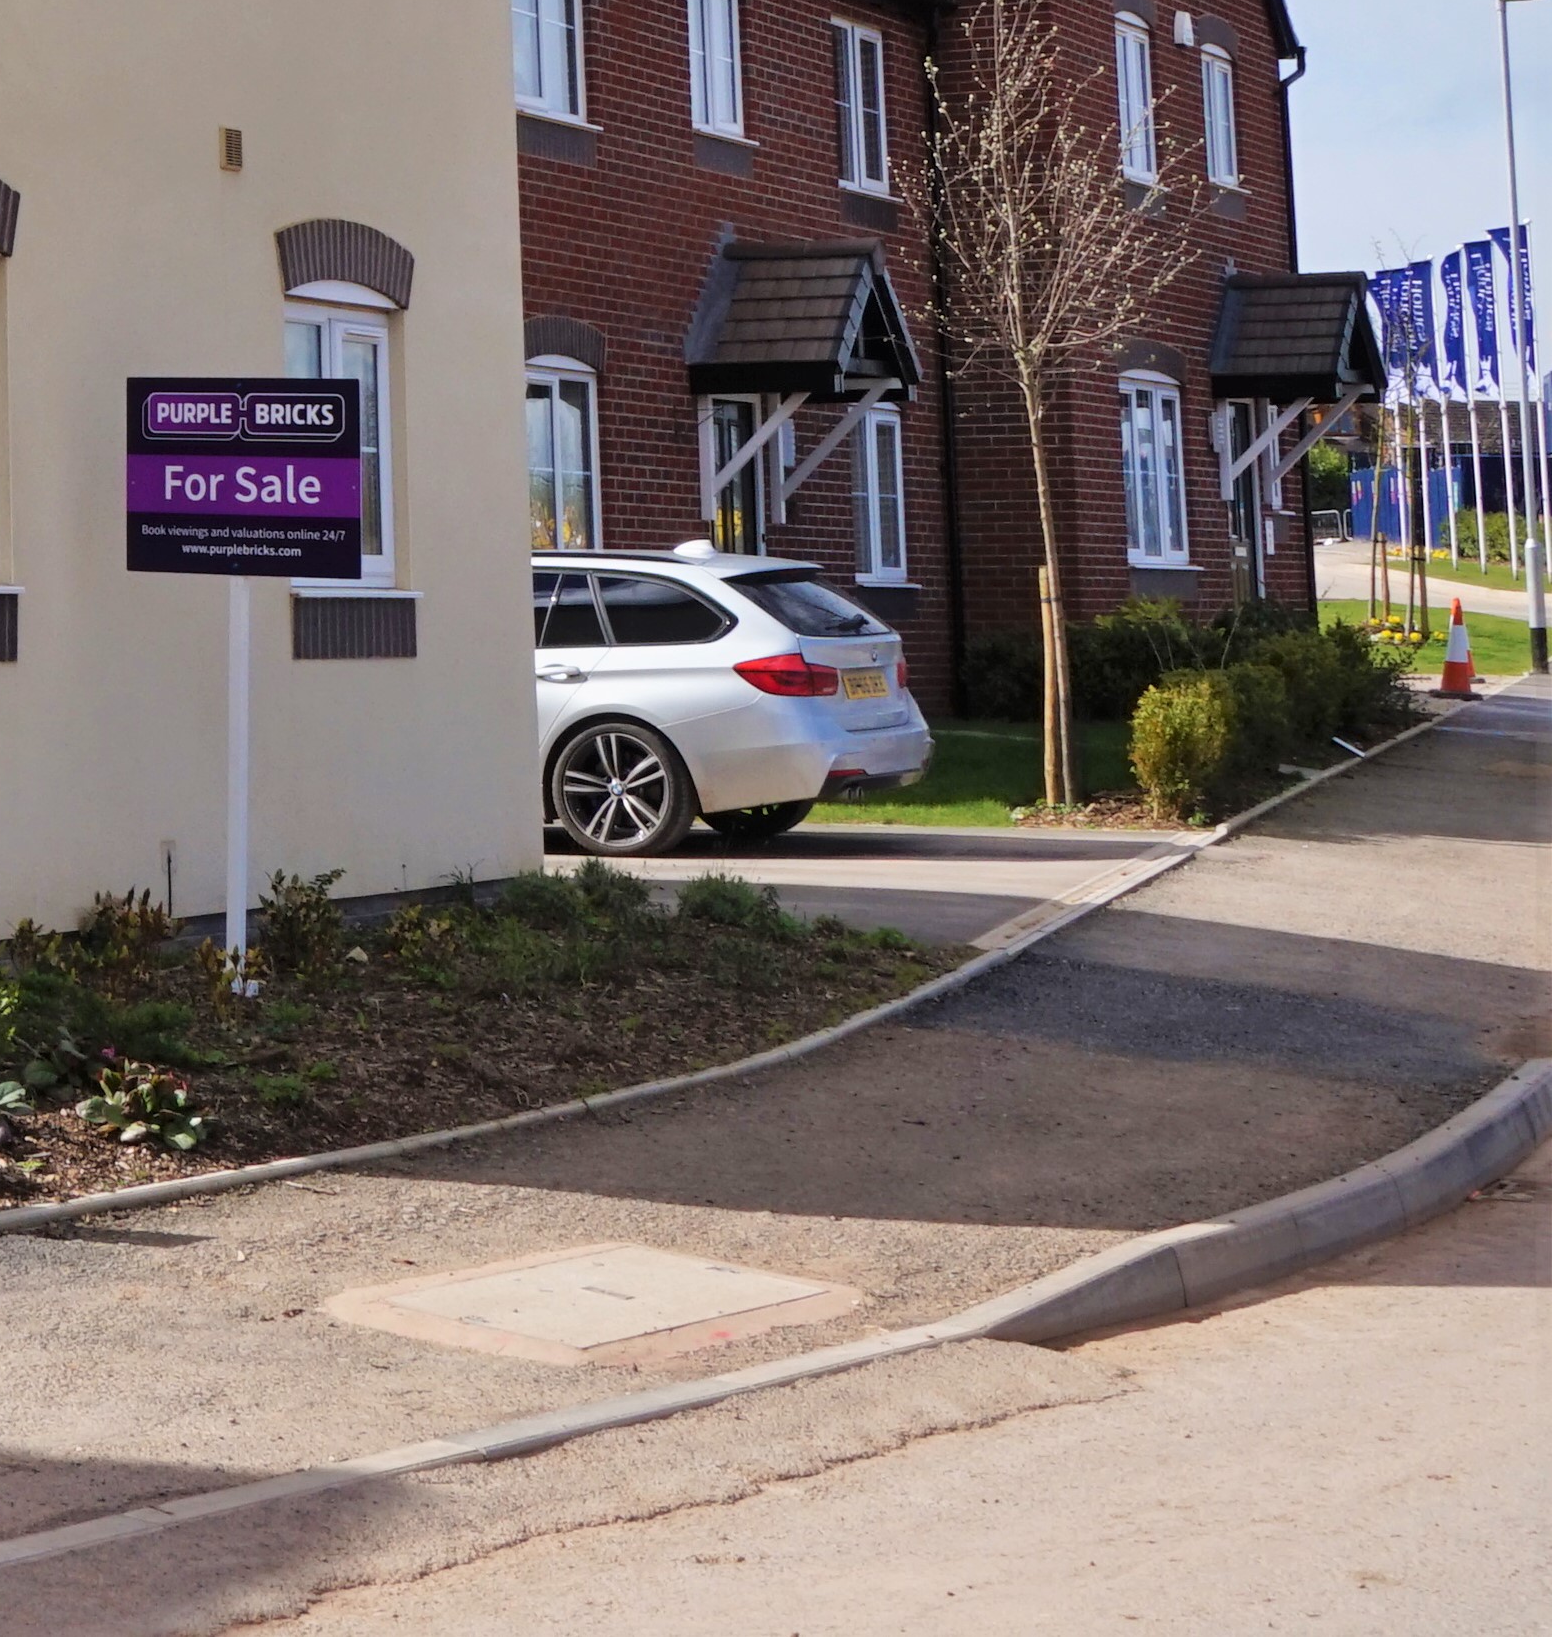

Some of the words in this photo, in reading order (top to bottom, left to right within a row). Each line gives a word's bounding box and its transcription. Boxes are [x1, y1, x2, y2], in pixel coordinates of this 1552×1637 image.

[157, 402, 232, 424] PURPLE
[255, 403, 334, 425] BRICKS
[164, 465, 225, 502] For
[234, 464, 321, 504] Sale
[141, 524, 167, 536] Book
[168, 525, 209, 539] viewings
[210, 527, 230, 538] and
[231, 527, 285, 539] valuations
[287, 529, 321, 540] online
[322, 530, 346, 542] 24/7
[182, 543, 302, 557] www.purplebricks.com
